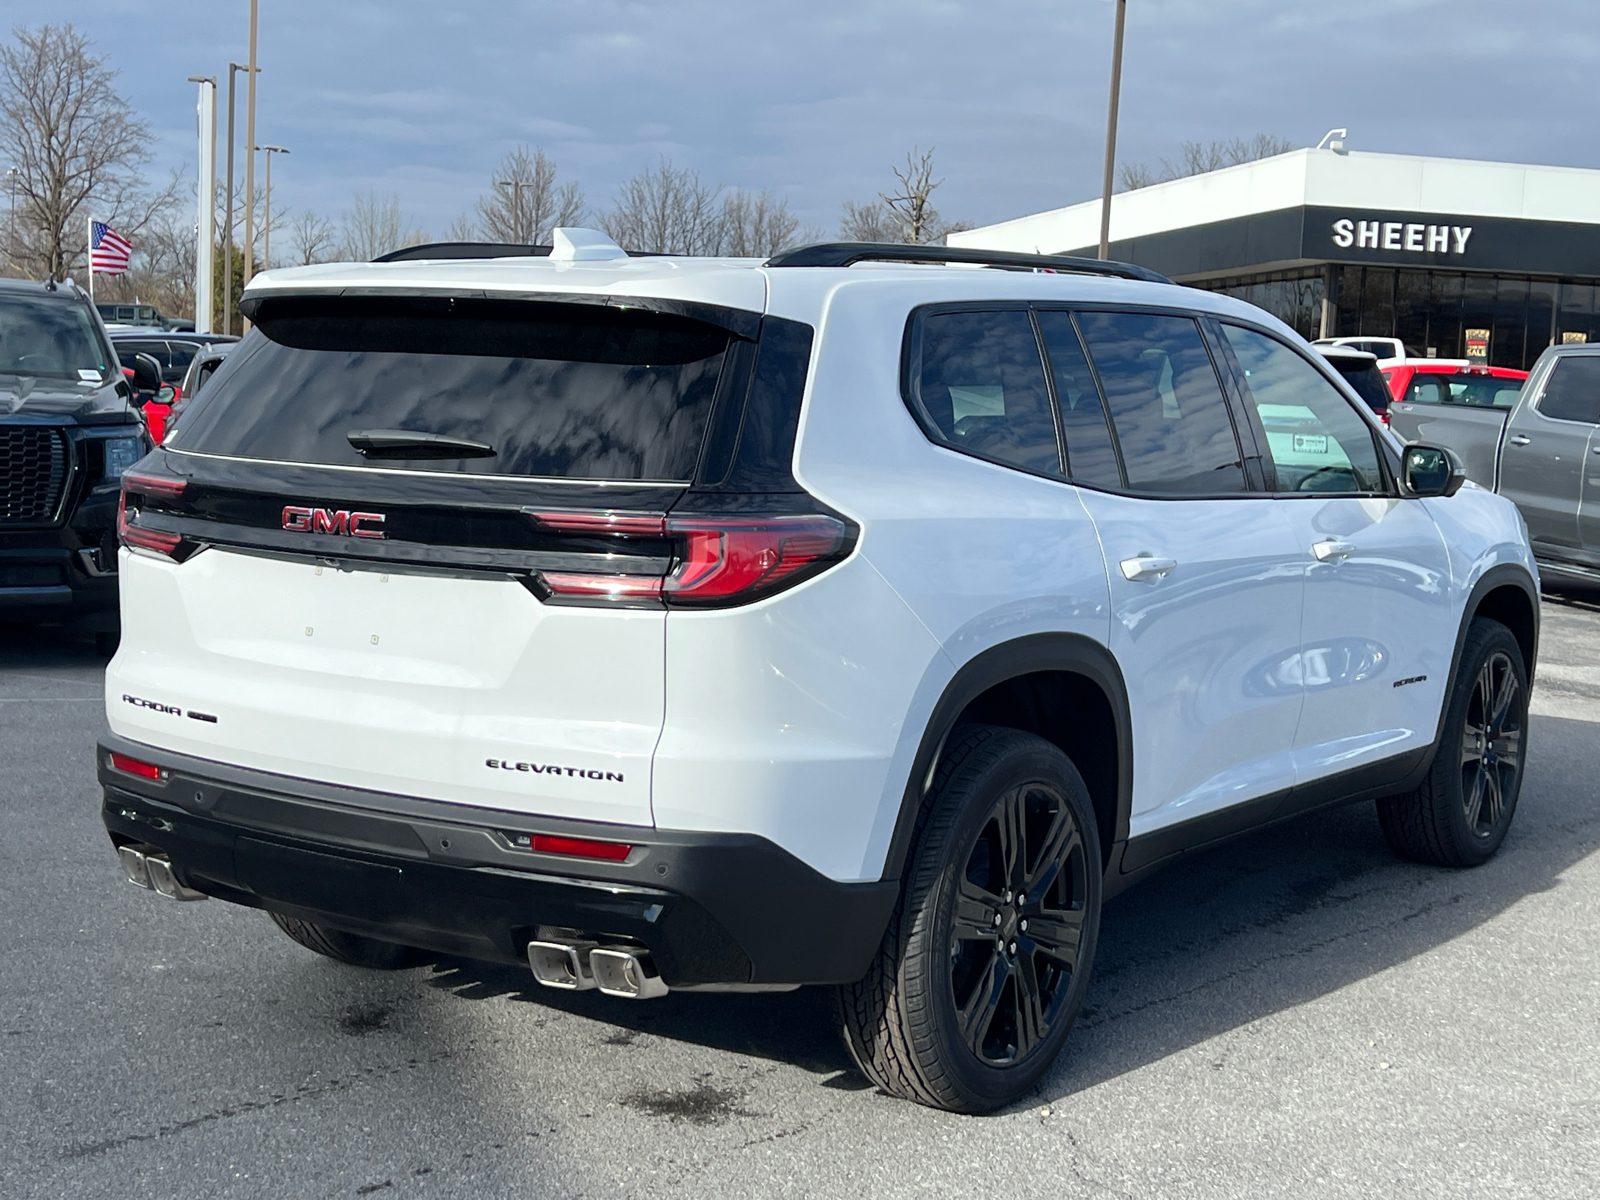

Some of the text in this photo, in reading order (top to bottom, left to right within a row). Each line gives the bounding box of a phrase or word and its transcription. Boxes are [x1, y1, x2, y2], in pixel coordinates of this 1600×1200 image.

[1331, 218, 1473, 254] SHEEHY
[1466, 349, 1487, 357] SALE
[282, 505, 386, 539] GMC
[1393, 675, 1427, 688] ACADIA
[122, 694, 182, 716] ACADIA
[485, 758, 624, 782] ELEVATION
